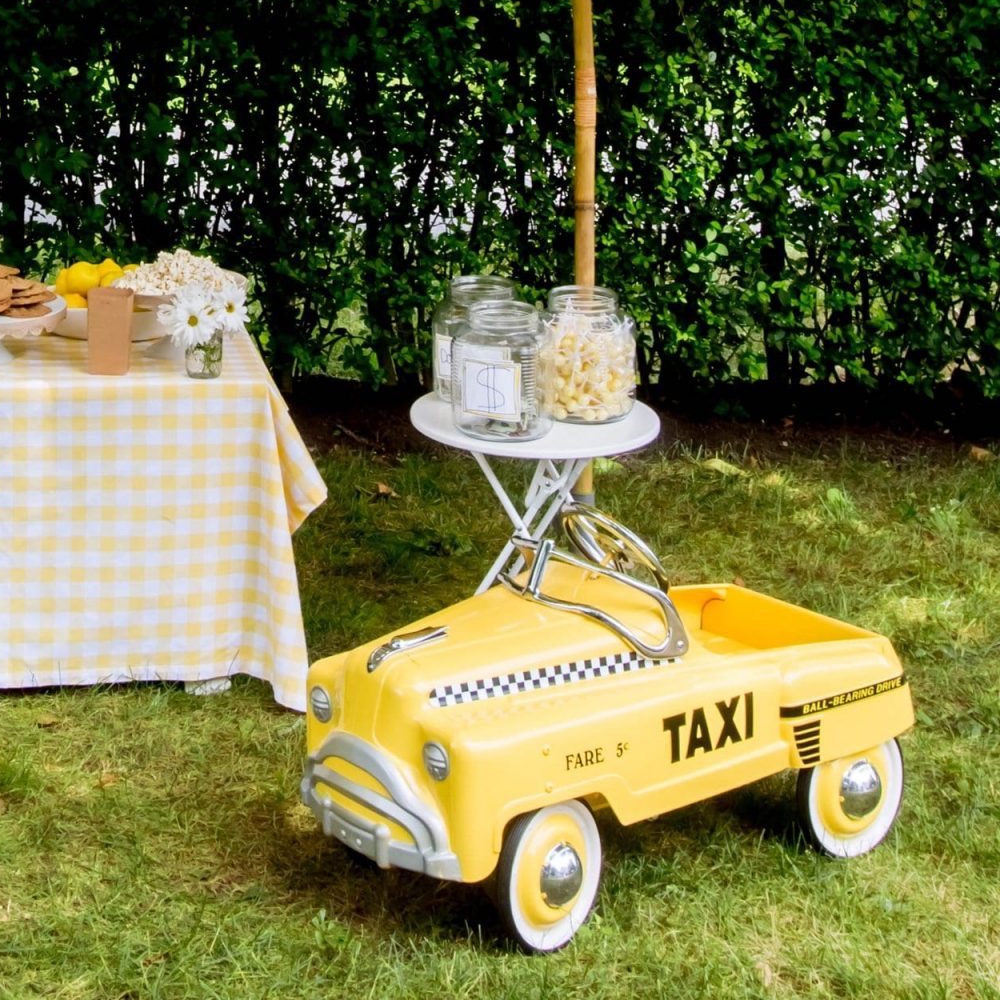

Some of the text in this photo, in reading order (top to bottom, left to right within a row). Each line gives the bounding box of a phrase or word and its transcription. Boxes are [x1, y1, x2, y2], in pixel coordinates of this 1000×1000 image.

[476, 364, 511, 413] $
[803, 677, 901, 714] BALL-BEARING DRIVE
[662, 691, 753, 764] TAXI
[565, 747, 605, 771] FARE
